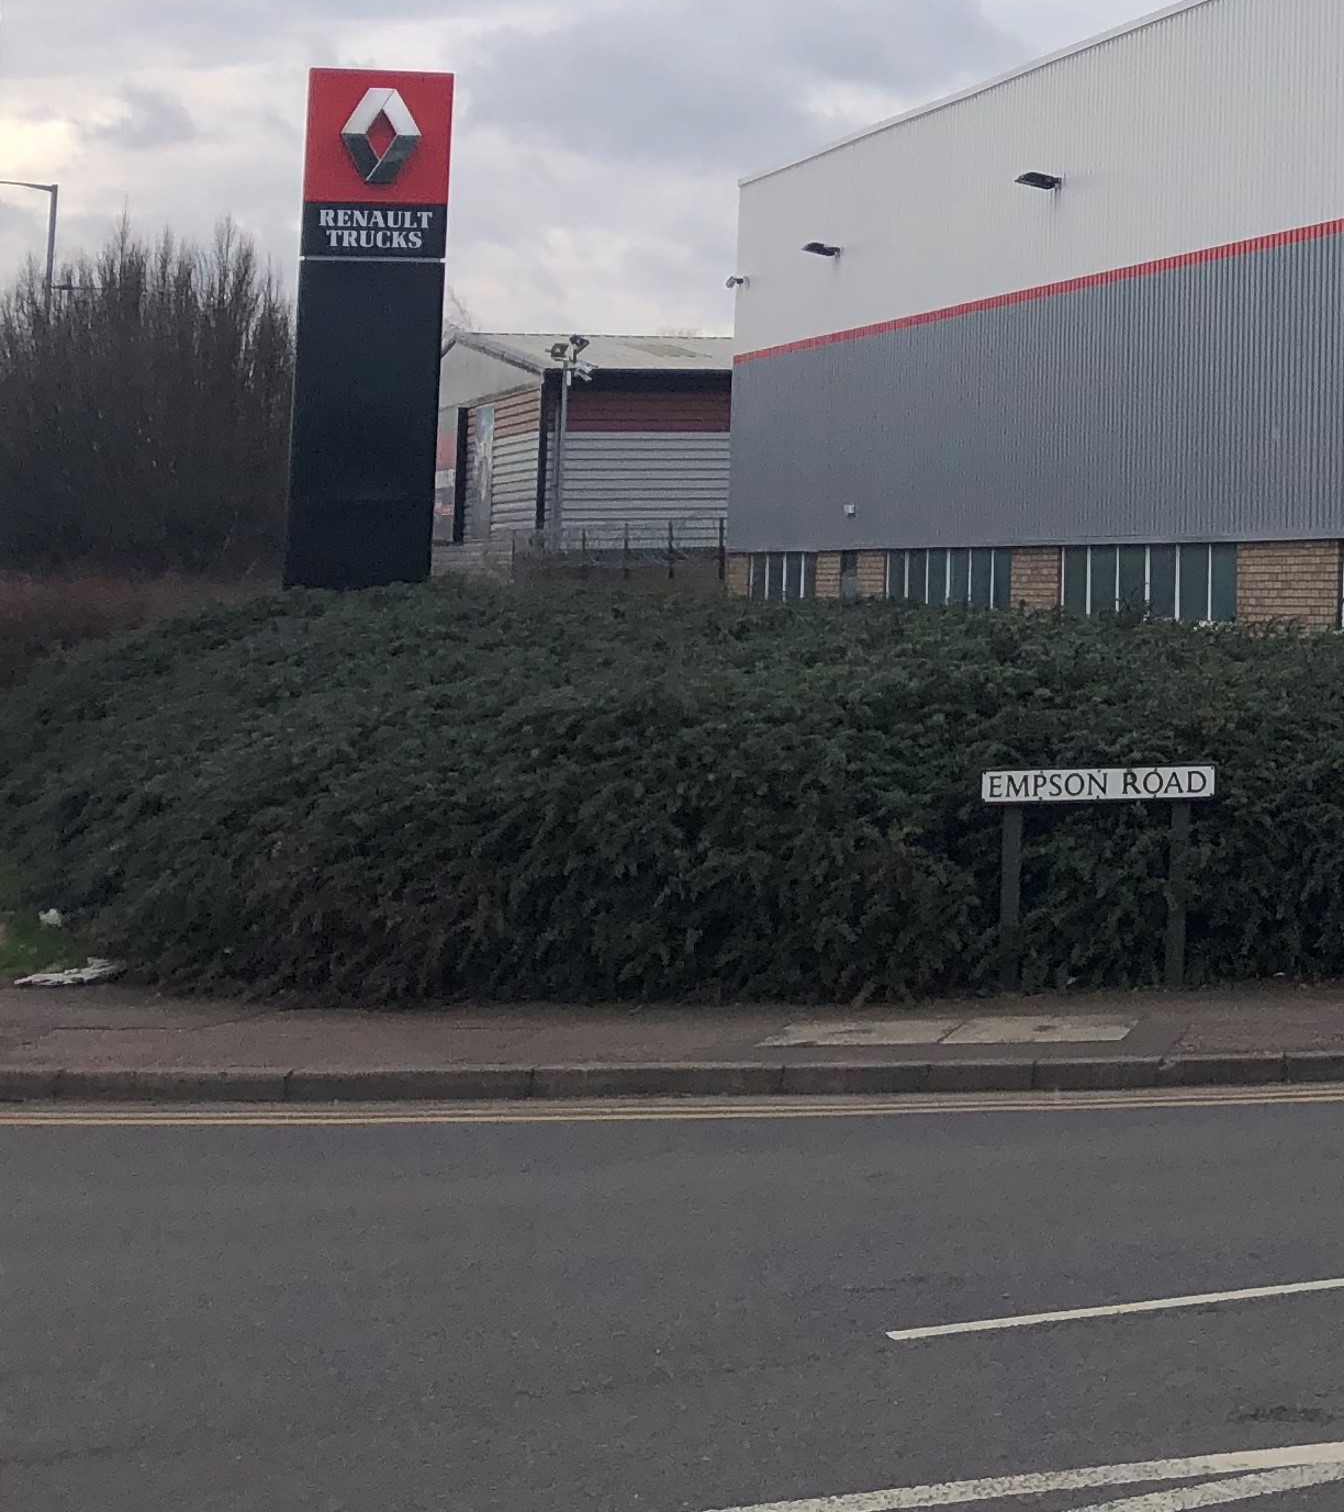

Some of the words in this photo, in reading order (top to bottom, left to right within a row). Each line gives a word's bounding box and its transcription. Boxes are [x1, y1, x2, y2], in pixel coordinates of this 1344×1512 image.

[318, 209, 433, 228] RENAULT
[325, 229, 423, 249] TRUCKS
[988, 772, 1108, 798] EMPSON
[1121, 770, 1207, 795] ROAD
